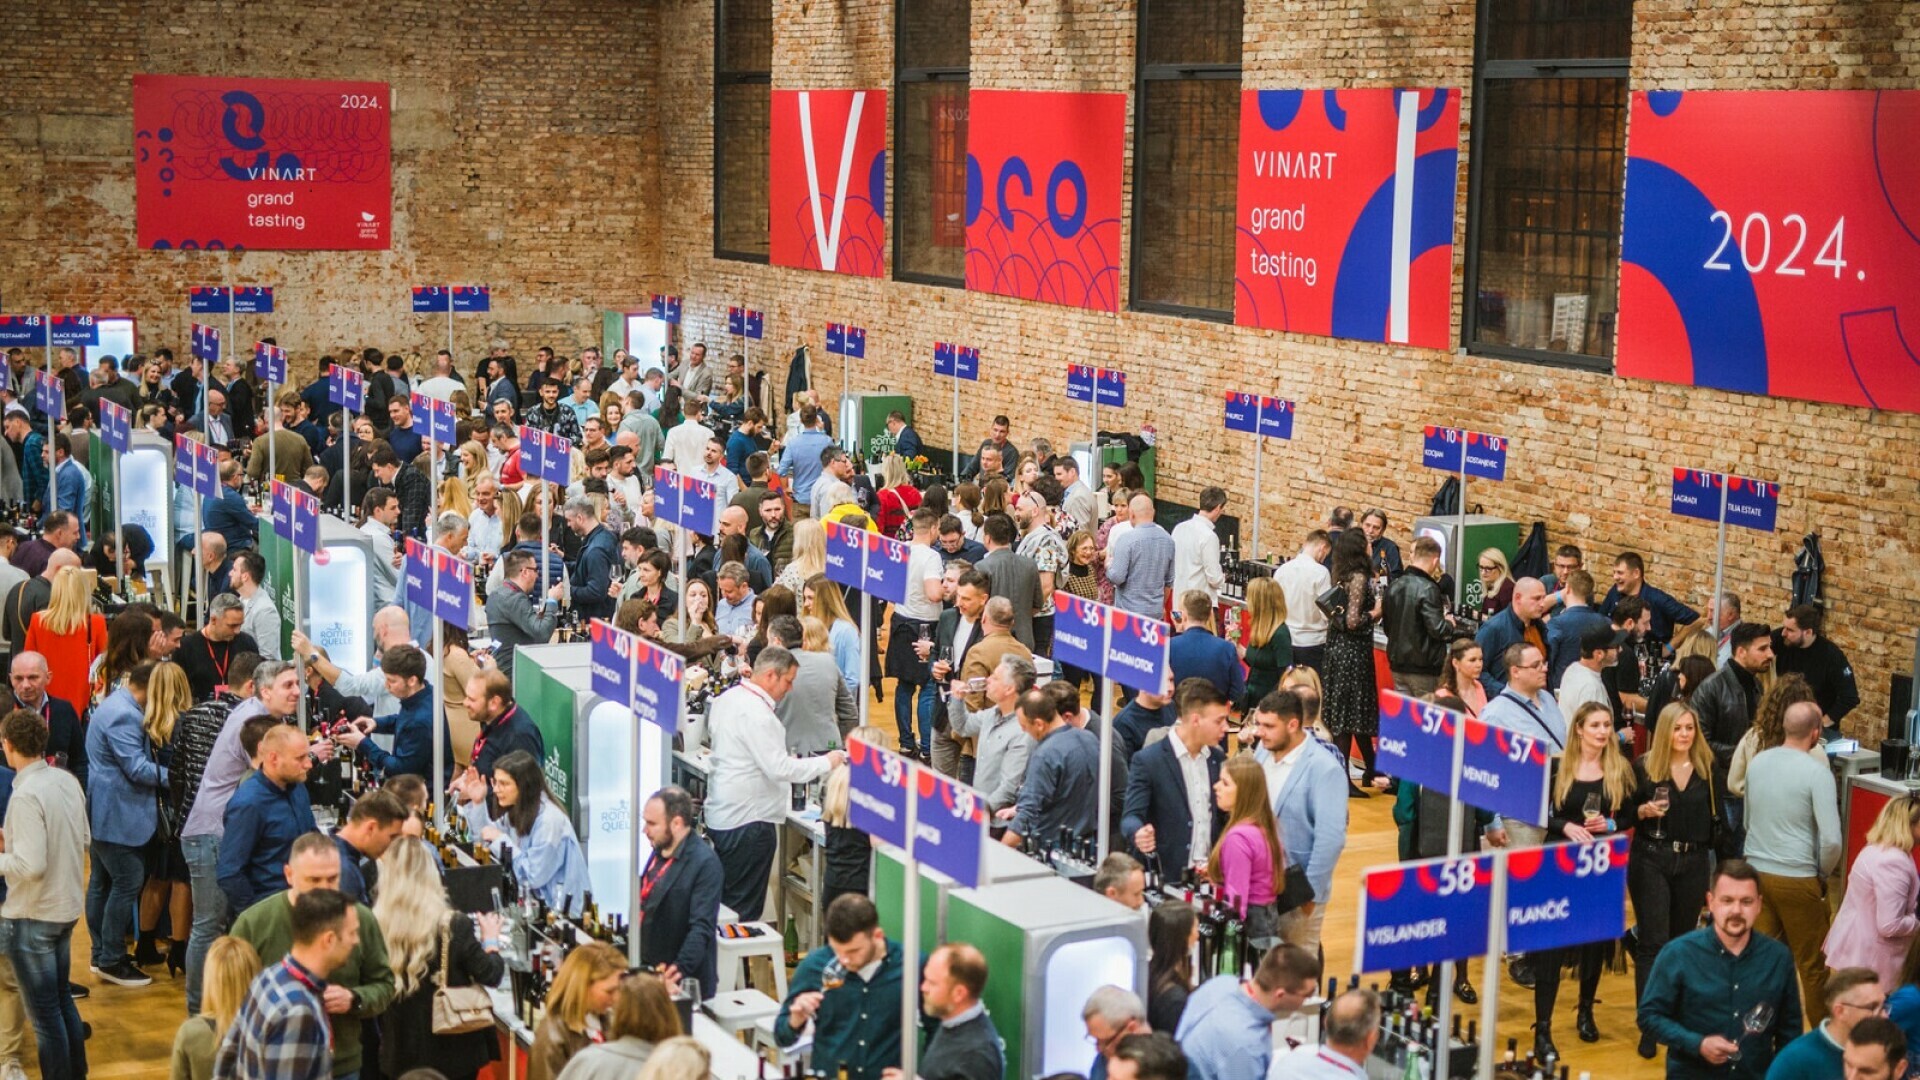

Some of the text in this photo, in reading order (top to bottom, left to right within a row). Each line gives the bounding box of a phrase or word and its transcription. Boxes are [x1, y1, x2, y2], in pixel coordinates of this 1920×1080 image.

[340, 95, 383, 109] 2024.
[247, 167, 317, 181] VINART
[1253, 151, 1337, 179] VINART
[247, 191, 294, 208] grand
[248, 213, 305, 230] tasting
[1251, 204, 1305, 235] grand
[1703, 210, 1866, 280] 2024.
[1250, 248, 1317, 287] tasting
[212, 287, 219, 296] 2
[255, 287, 262, 296] 2
[432, 286, 439, 296] 3
[473, 286, 479, 296] 3
[25, 316, 40, 326] 48
[78, 316, 93, 326] 48
[1082, 366, 1088, 379] 8
[1112, 371, 1118, 384] 8
[444, 402, 452, 417] 52
[1243, 394, 1250, 407] 9
[1279, 400, 1286, 413] 9
[532, 430, 540, 446] 53
[1446, 429, 1457, 444] 10
[1489, 436, 1500, 452] 10
[558, 438, 566, 455] 53
[668, 472, 678, 490] 54
[1701, 473, 1710, 488] 11
[701, 481, 710, 500] 54
[1674, 493, 1698, 505] LAGRADI
[1756, 482, 1765, 498] 11
[1727, 503, 1762, 517] TILIA ESTATE
[846, 528, 859, 549] 55
[421, 546, 431, 569] 41
[889, 541, 902, 563] 55
[455, 561, 465, 584] 41
[1082, 602, 1100, 627] 56
[1141, 620, 1159, 647] 56
[613, 631, 630, 660] 40
[660, 654, 678, 682] 40
[1109, 648, 1155, 675] ZLATAN OTOK
[1421, 706, 1444, 736] 57
[1507, 733, 1534, 764] 57
[880, 752, 903, 787] 39
[1463, 764, 1500, 789] VENTUS
[951, 785, 975, 822] 39
[1576, 841, 1610, 877] 58
[1437, 860, 1476, 896] 58
[1509, 896, 1571, 925] PLANČIĆ
[1367, 917, 1447, 946] VISLANDER
